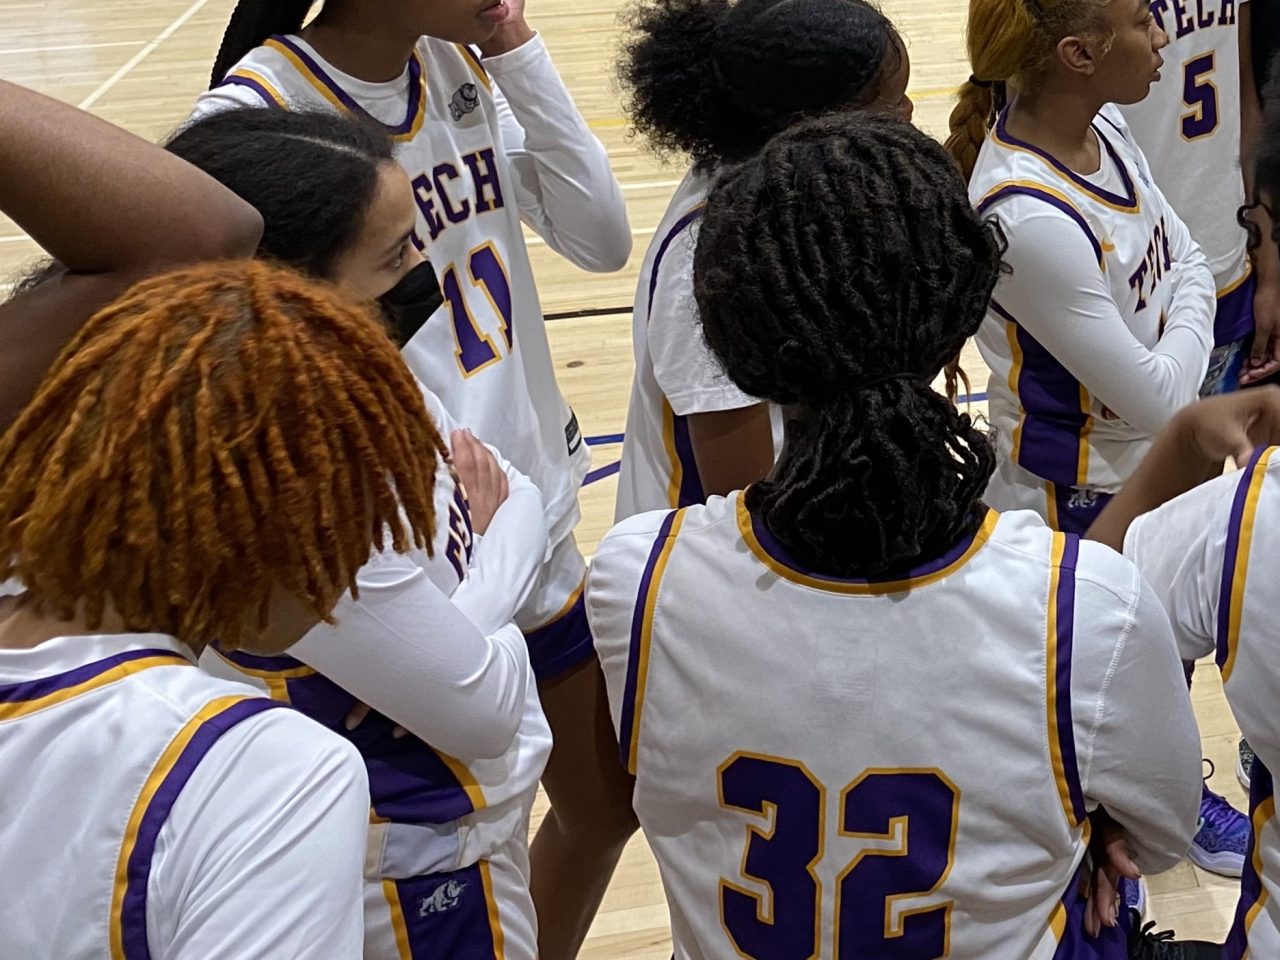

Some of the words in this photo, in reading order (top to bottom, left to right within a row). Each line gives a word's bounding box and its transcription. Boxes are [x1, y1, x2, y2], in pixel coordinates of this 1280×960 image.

[1179, 49, 1220, 143] 5
[410, 147, 504, 252] ECH
[441, 240, 514, 380] 11
[716, 749, 961, 960] 32
